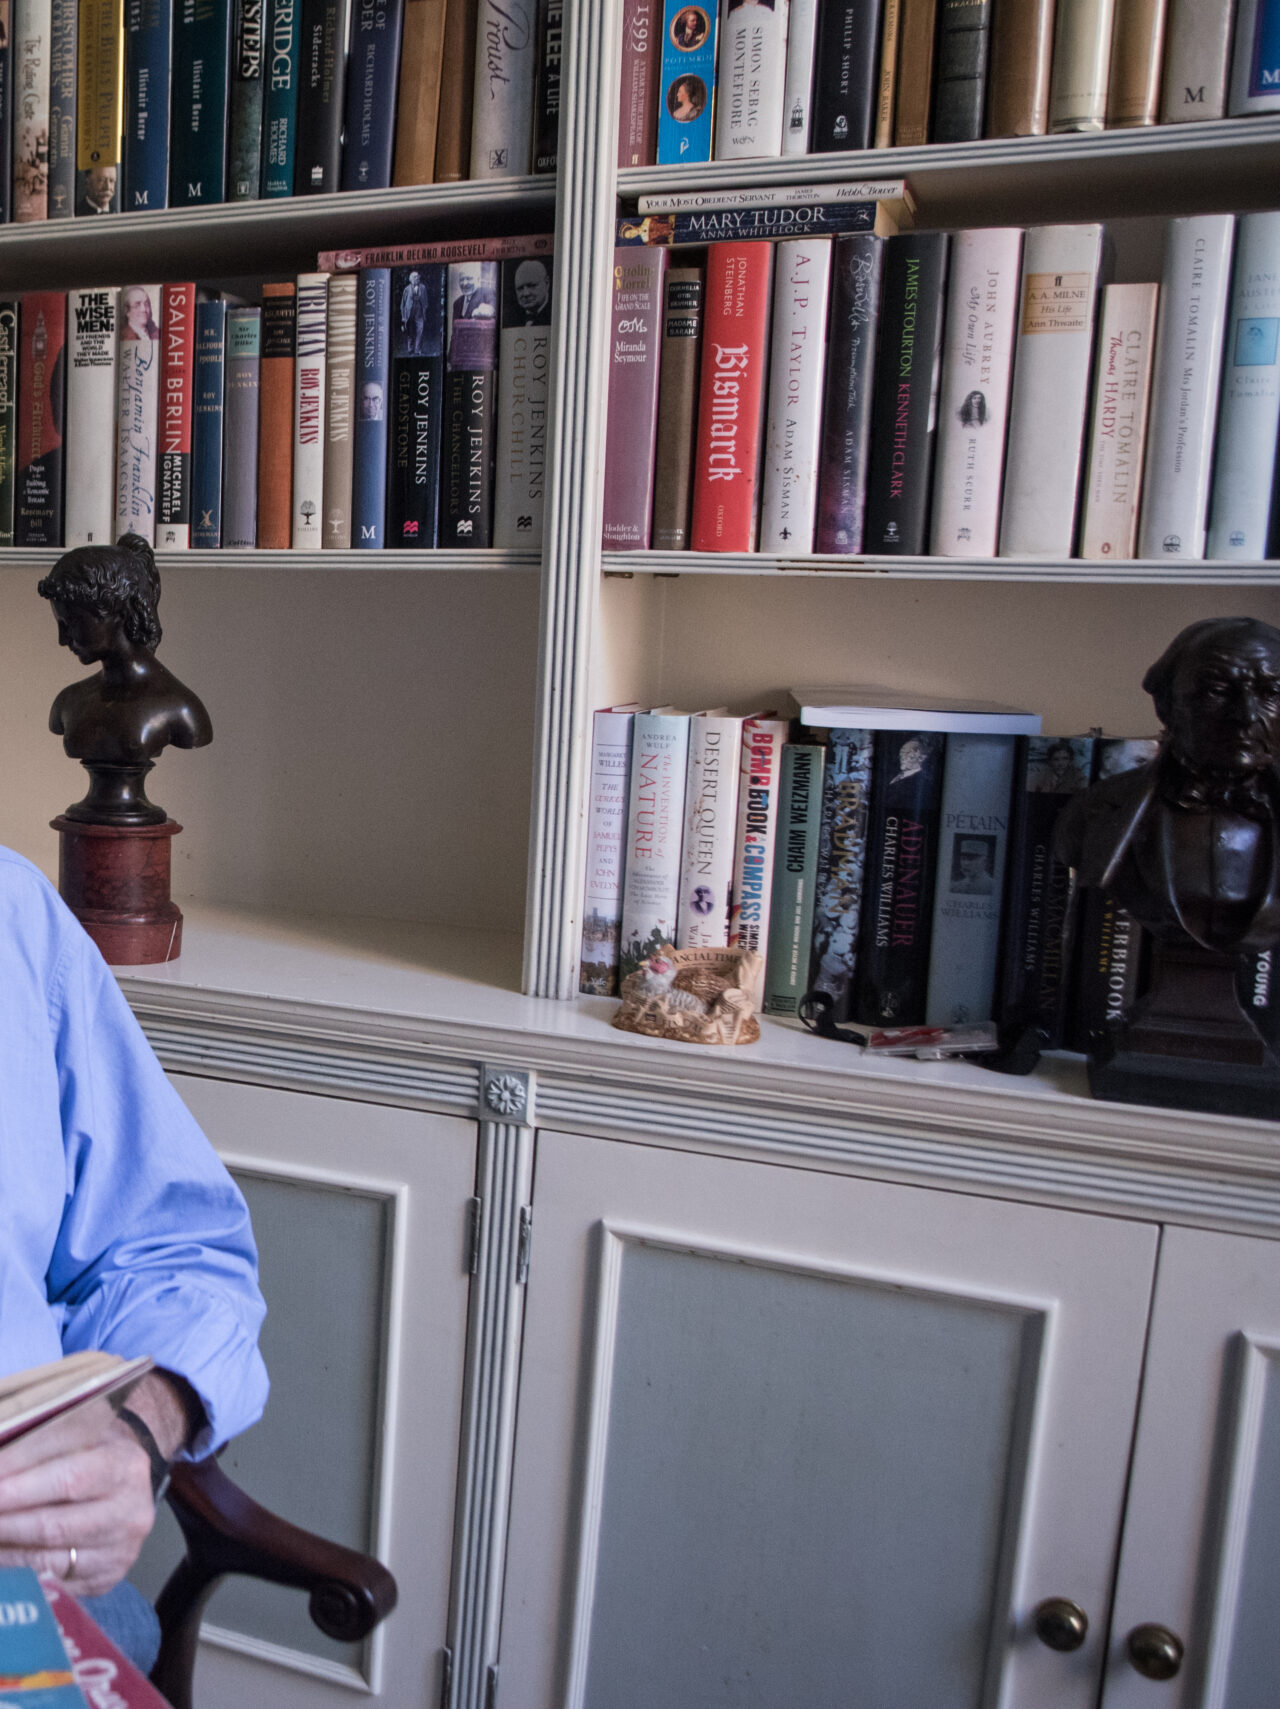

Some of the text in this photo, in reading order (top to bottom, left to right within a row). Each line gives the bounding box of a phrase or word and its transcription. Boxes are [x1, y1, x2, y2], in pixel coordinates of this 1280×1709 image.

[311, 25, 322, 87] Sidetracks
[323, 7, 336, 103] Richard Holmes
[486, 0, 530, 82] Proust
[632, 5, 649, 52] 1599
[840, 9, 853, 95] PHILIP SHORT
[100, 2, 114, 148] THE BULLY PULPIT
[361, 44, 375, 146] RICHARD HOLMES
[730, 28, 746, 129] MONTEFIORE
[747, 28, 763, 127] SIMON SEBAG
[1184, 87, 1204, 103] M
[61, 116, 73, 158] Gianni
[269, 120, 278, 164] HOLMES
[277, 118, 287, 165] RICHARD
[629, 95, 637, 145] SHAKESPEARE
[188, 182, 202, 197] M
[646, 193, 776, 209] YOUR MOST OBEDIENT SERVANT
[689, 207, 825, 231] MARY TUDOR
[365, 251, 404, 264] FRANKLIN
[407, 248, 437, 261] DELANO
[440, 244, 487, 257] ROOSEVELT
[700, 225, 812, 240] ANNA WHITELOCK
[76, 307, 114, 319] WISE
[79, 294, 109, 306] THE
[298, 282, 326, 357] TRUMAN
[328, 280, 357, 364] BALDWIN
[364, 280, 376, 368] ROY JENKINS
[723, 257, 734, 315] STEINBERG
[735, 257, 746, 317] JONATHAN
[899, 258, 920, 377] JAMES STOURTON
[77, 321, 114, 333] MEN:
[615, 352, 646, 364] Seymour
[616, 340, 646, 352] Miranda
[963, 287, 980, 366] My Own Life
[980, 270, 999, 384] JOHN AUBREY
[1173, 238, 1206, 473] CLAIRE TOMALIN Mrs Jordan's Profession
[165, 287, 185, 454] ISAIAH BERLIN
[300, 369, 319, 445] ROY JENKINS
[330, 368, 349, 443] ROY JENKINS
[1101, 331, 1123, 438] Thomas HARDY
[119, 349, 130, 516] WALTER ISAACSON
[130, 342, 153, 516] Benjamin Franklin
[397, 371, 411, 468] GLADSTONE
[415, 371, 429, 484] ROY JENKINS
[468, 376, 484, 514] ROY JENKINS
[510, 338, 527, 484] CHURCHILL
[528, 338, 548, 499] ROY JENKINS
[708, 343, 749, 482] Bismarck
[890, 384, 911, 498] KENNETH CLARK
[1112, 331, 1142, 503] CLAIRE TOMALIN
[162, 456, 172, 522] IGNATIEFF
[171, 456, 182, 513] MICHAEL
[780, 419, 797, 519] ADAM SISMAN
[841, 430, 854, 514] ADAM SISMAN
[962, 438, 976, 511] RUTH SCURR
[20, 509, 54, 517] Rosemary
[360, 525, 376, 539] M
[716, 505, 725, 537] OXFORD
[634, 753, 659, 859] NATURE
[656, 754, 672, 858] The INVENTION of
[697, 732, 721, 876] DESERT QUEEN
[790, 752, 811, 824] WEIZMANN
[787, 830, 804, 872] CHAIM
[828, 782, 860, 913] BRADMAN
[876, 817, 898, 947] CHARLES WILLIAMS
[892, 819, 924, 947] ADENAUER
[748, 925, 759, 951] SIMON
[1024, 845, 1045, 972] CHARLES WILLIAMS
[1253, 950, 1272, 1007] YOUNG
